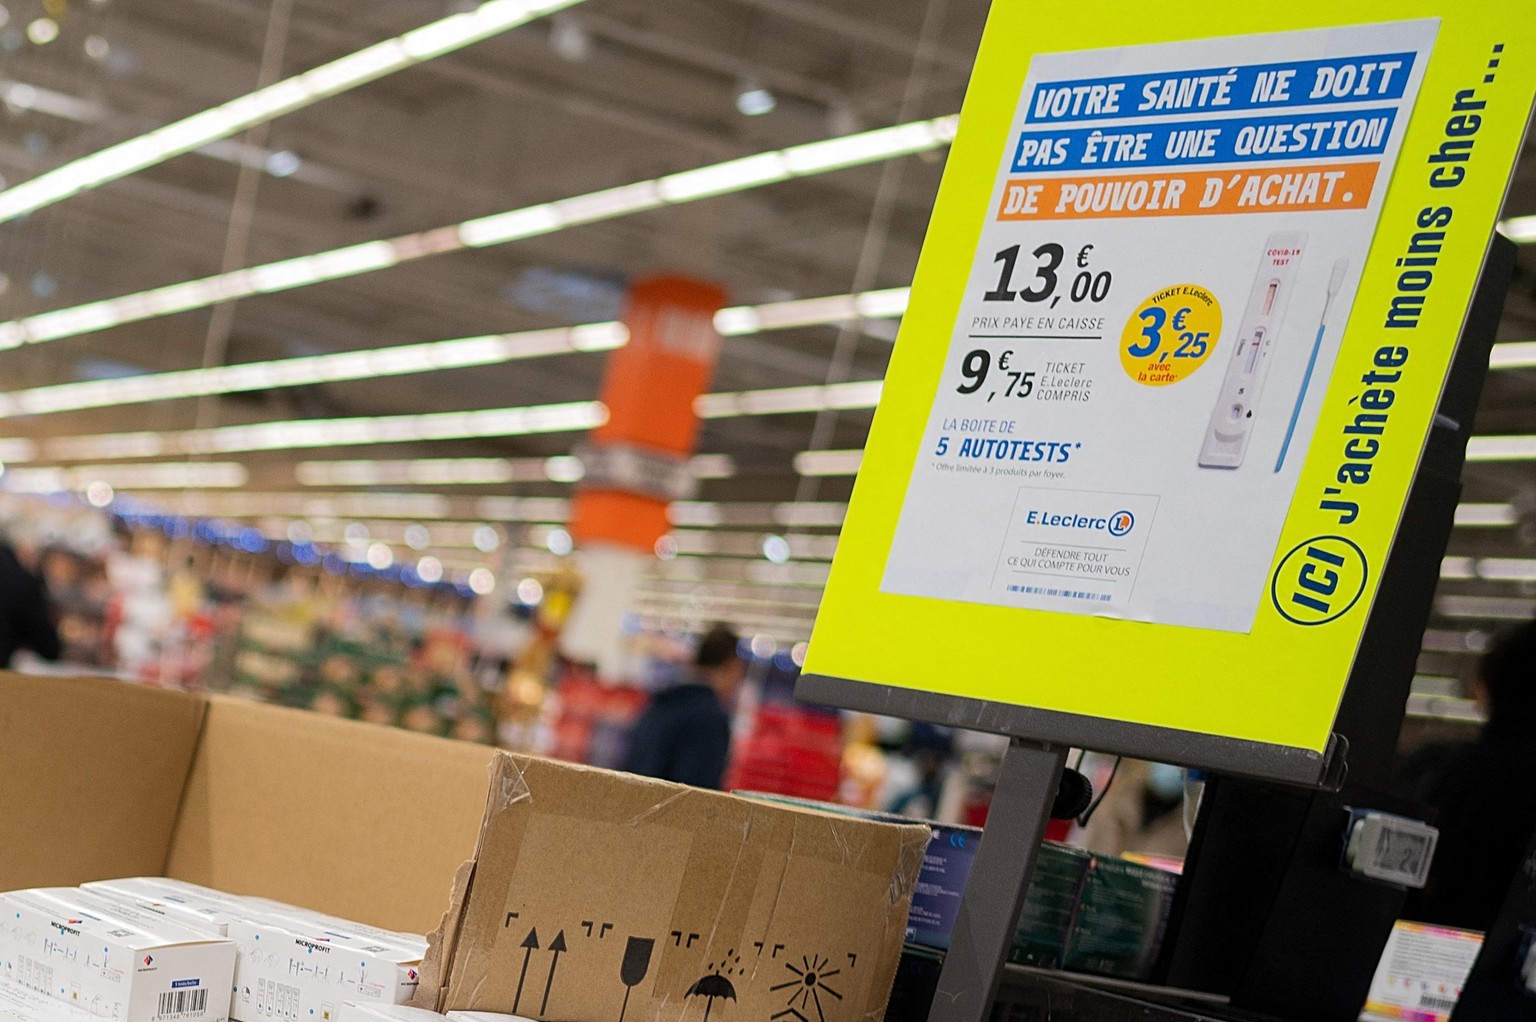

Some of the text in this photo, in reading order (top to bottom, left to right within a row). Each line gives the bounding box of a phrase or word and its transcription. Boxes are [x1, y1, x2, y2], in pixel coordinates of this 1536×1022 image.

[1033, 61, 1403, 119] VOTRE SANTÉ NE DOIT
[1017, 117, 1388, 167] PAS ÊTRE UNE QUESTION
[1003, 171, 1355, 214] DE POUVOIR D'ACHAT.
[1267, 249, 1301, 257] COVID-19
[1152, 287, 1181, 304] TICKET
[971, 317, 1105, 330] PRIX PAYE EN CAISSE
[1045, 362, 1085, 374] TICKET
[1147, 363, 1171, 371] avec
[1040, 376, 1093, 389] E.Leclerc
[1137, 372, 1147, 381] la
[1036, 389, 1091, 402] COMPRIS
[1291, 546, 1346, 615] ICI
[1319, 344, 1410, 526] J'achète
[1384, 205, 1455, 330] moins
[942, 418, 1016, 434] LA BOITE DE
[935, 437, 950, 457] 5
[935, 462, 955, 472] Offre
[994, 466, 1028, 478] produits
[1028, 470, 1042, 479] par
[1026, 510, 1107, 531] E.Leclerc
[1034, 547, 1109, 563] DÉFENDRE TOUT
[1007, 556, 1131, 577] CE QUI COMPTE POUR VOUS
[50, 920, 81, 937] MICROPROFIT
[294, 938, 331, 954] MICROPROFIT
